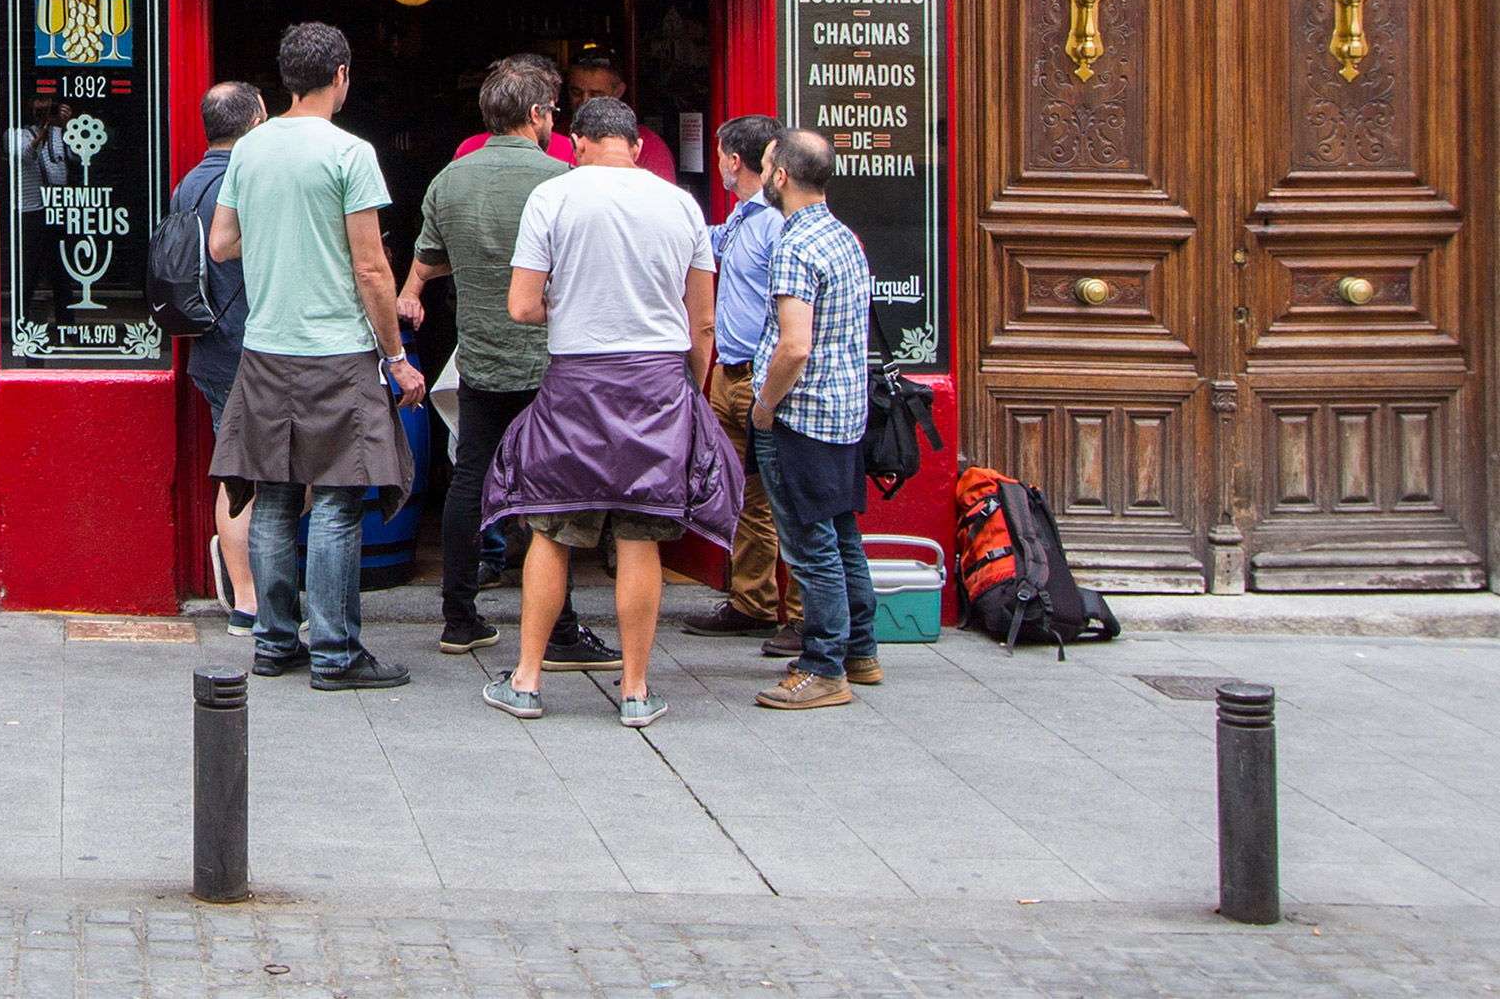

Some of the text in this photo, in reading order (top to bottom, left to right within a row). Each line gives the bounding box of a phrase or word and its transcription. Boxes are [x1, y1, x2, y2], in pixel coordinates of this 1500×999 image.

[813, 22, 910, 45] CHACINAS
[808, 64, 915, 86] AHUMADOS
[62, 76, 106, 98] 1.892
[817, 105, 908, 127] ANCHOAS
[852, 131, 872, 150] DE
[832, 154, 915, 176] NTABRIA
[40, 187, 113, 208] VERMUT
[46, 207, 129, 235] DE REUS
